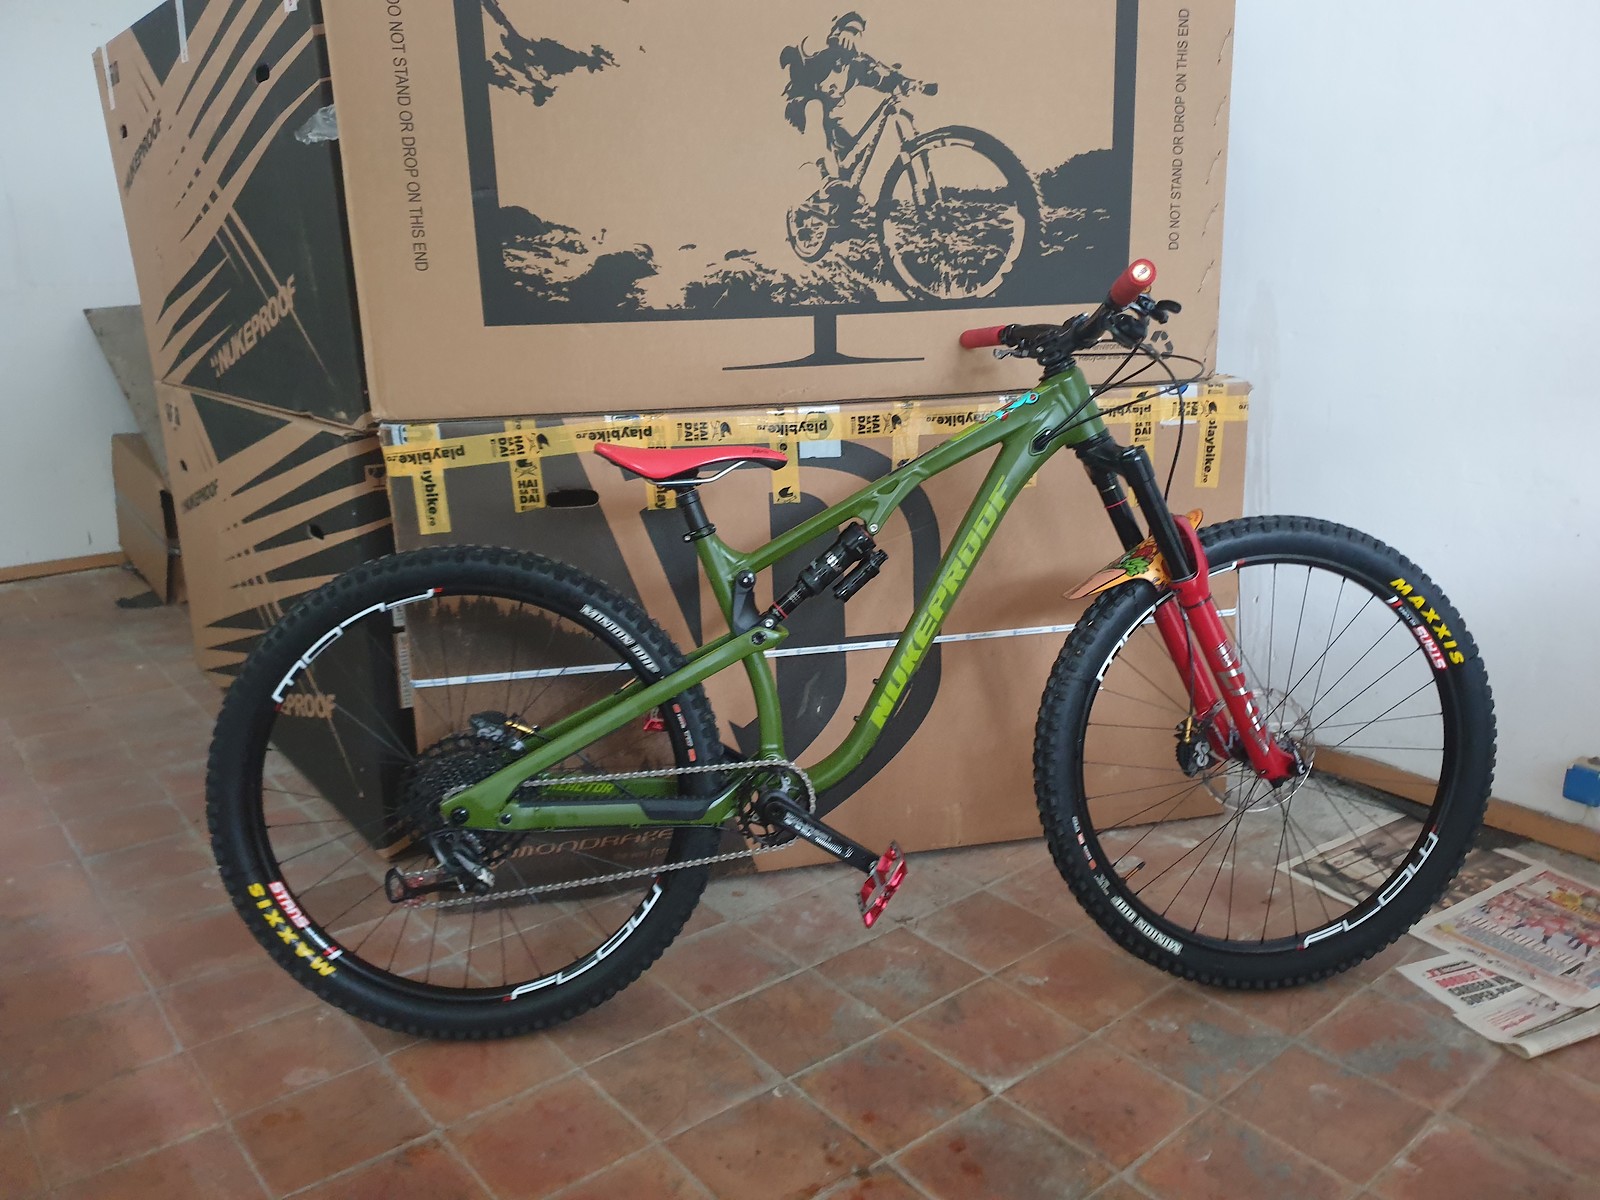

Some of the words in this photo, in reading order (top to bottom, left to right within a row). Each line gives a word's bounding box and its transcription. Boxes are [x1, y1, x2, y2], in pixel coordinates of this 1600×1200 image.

[1178, 8, 1190, 37] END
[389, 22, 406, 53] NOT
[1176, 41, 1188, 71] THIS
[393, 57, 411, 106] STAND
[1175, 73, 1187, 93] ON
[399, 111, 414, 132] OR
[1173, 96, 1186, 132] DROP
[1172, 136, 1183, 155] OR
[402, 136, 419, 177] DROP
[1171, 159, 1183, 200] STAND
[407, 182, 421, 202] ON
[409, 207, 425, 238] THIS
[1170, 203, 1180, 228] NOT
[1168, 232, 1180, 250] DO
[413, 243, 429, 272] END
[684, 422, 693, 441] DAI
[700, 421, 709, 441] HAI
[857, 415, 866, 434] DAI
[872, 414, 881, 433] HAI
[1135, 426, 1152, 436] DAI
[514, 435, 526, 455] HAI
[576, 426, 652, 443] playbike.ro
[386, 445, 465, 465] playbike.ro
[498, 437, 509, 458] DAI
[517, 479, 538, 489] HAI
[520, 494, 540, 504] DAI
[870, 474, 1007, 729] NUKEPROOF
[580, 603, 637, 648] MINION
[1390, 577, 1465, 665] MAXXIS
[247, 882, 337, 977] MAXXIS
[1133, 915, 1184, 956] MINION
